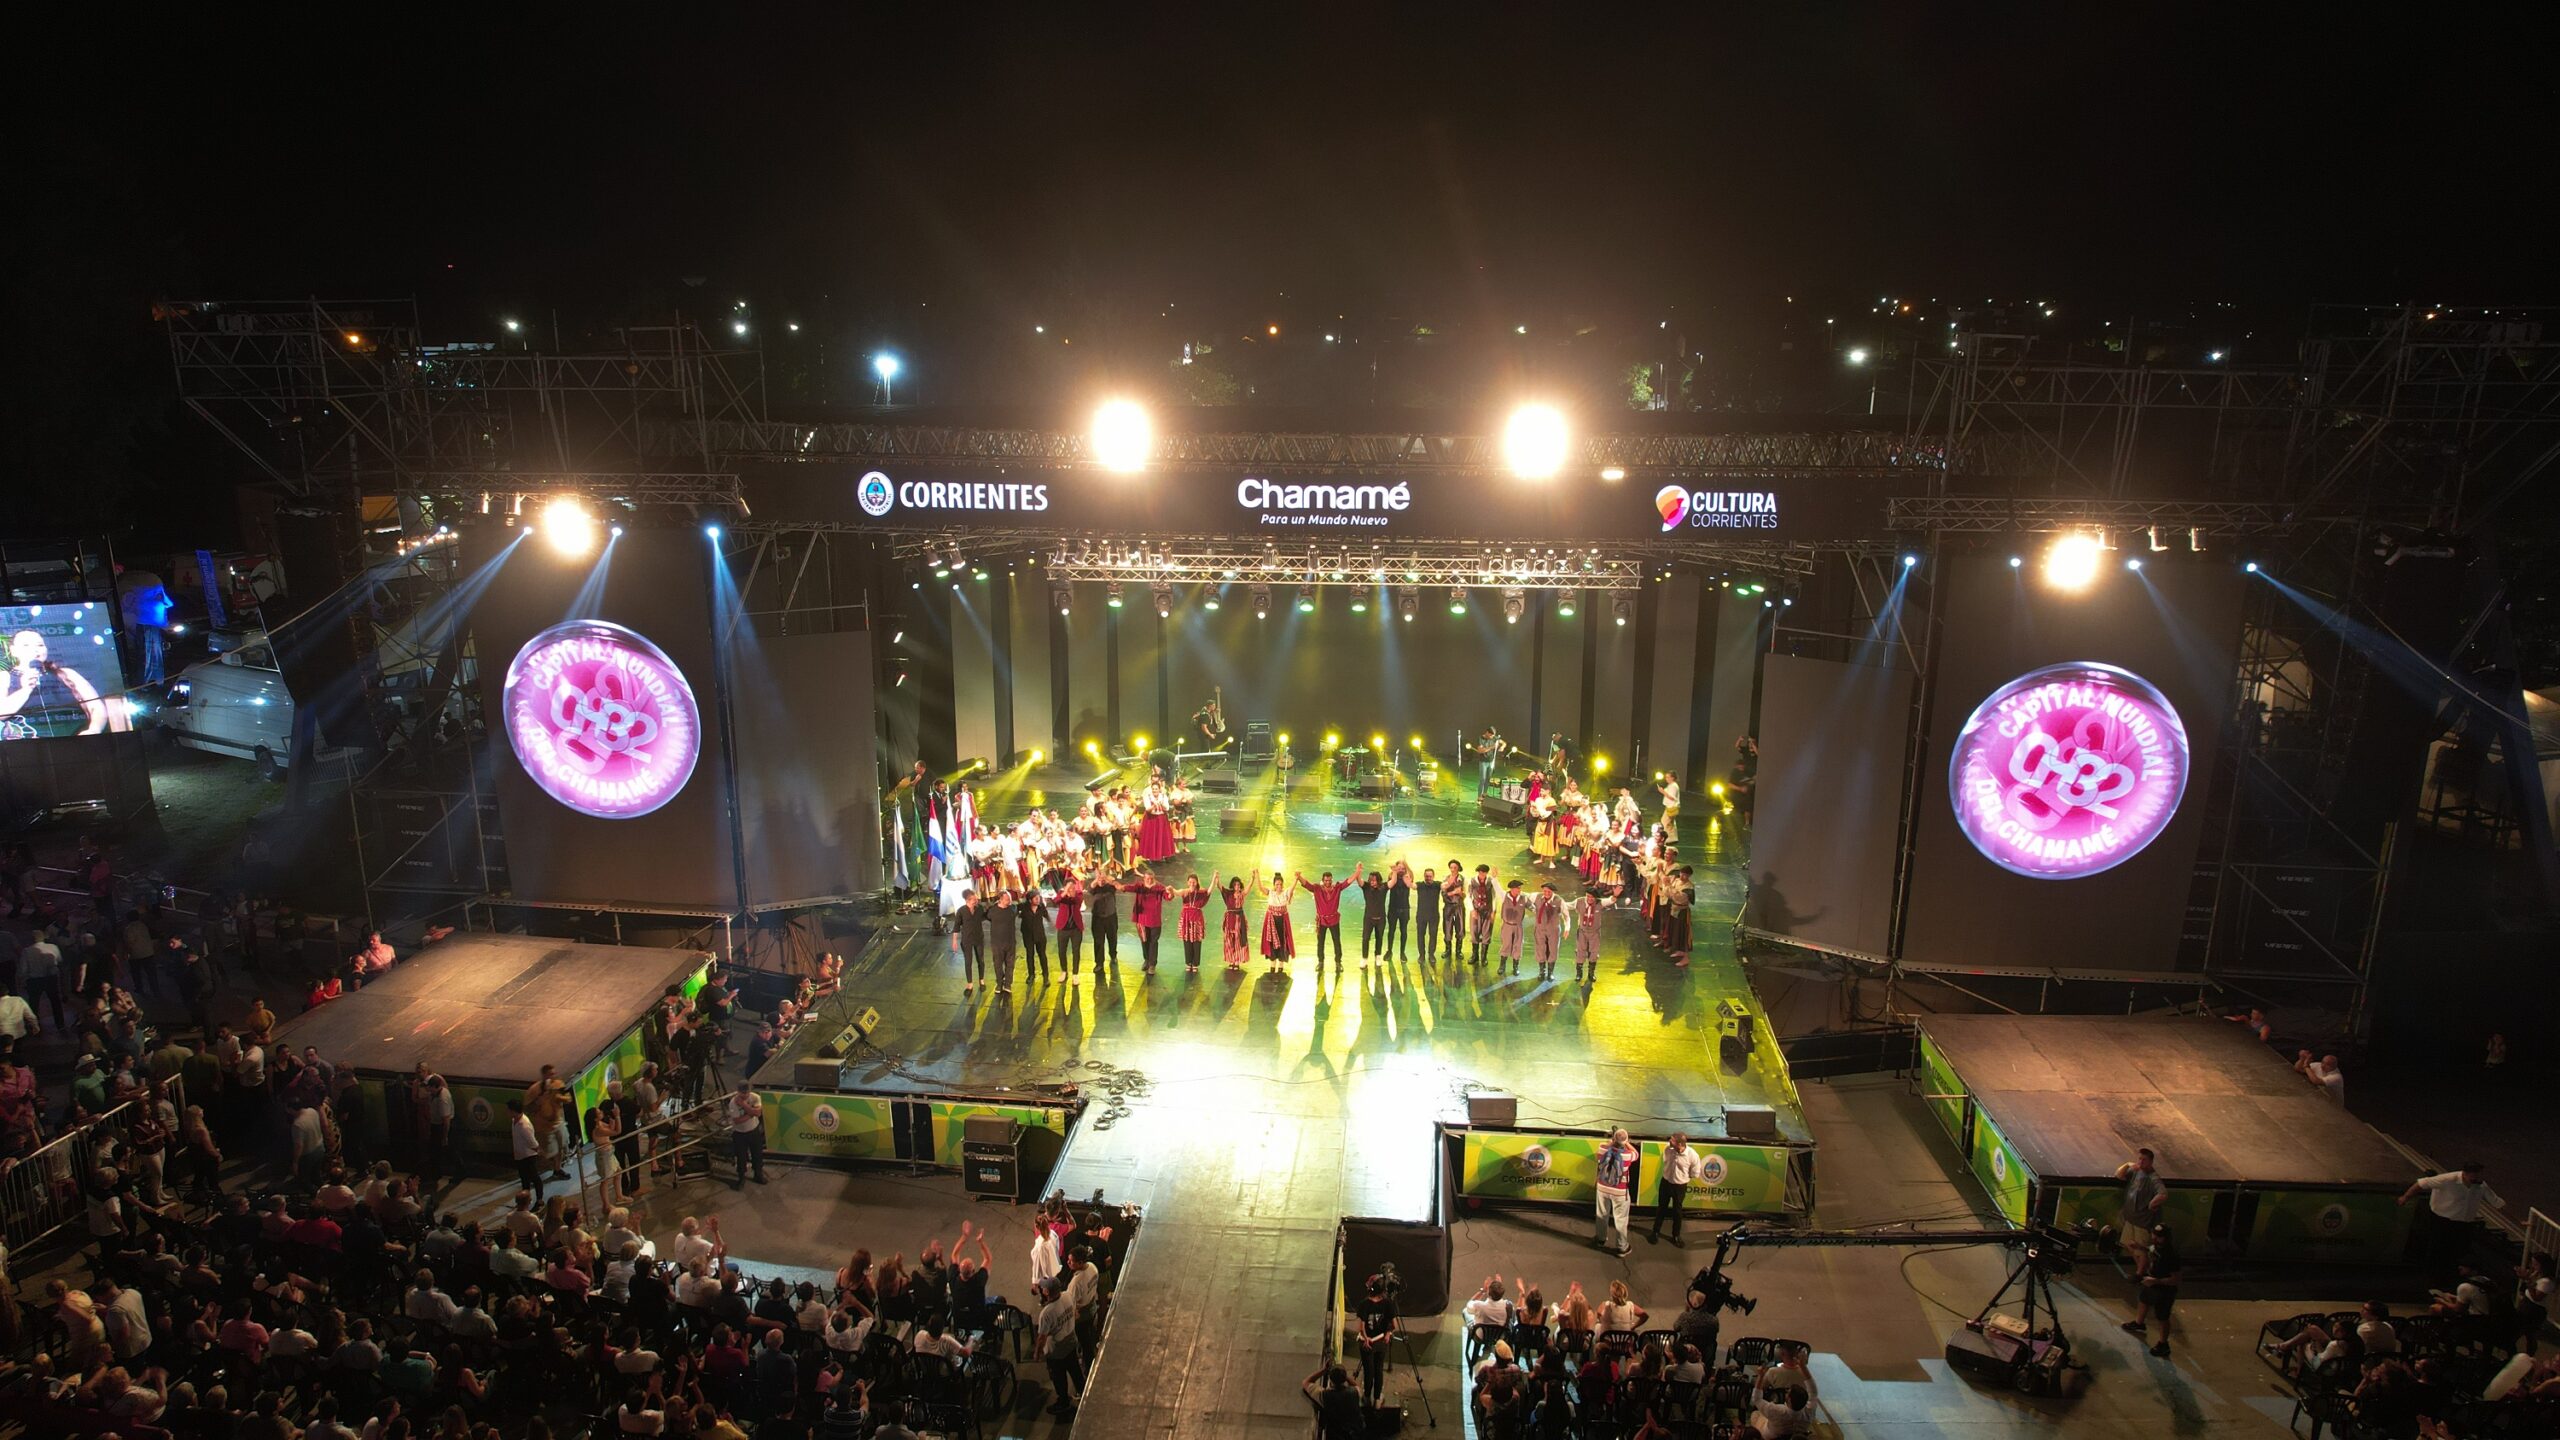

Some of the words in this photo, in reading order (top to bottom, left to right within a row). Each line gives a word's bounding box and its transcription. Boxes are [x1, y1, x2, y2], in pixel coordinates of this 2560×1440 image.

[900, 482, 1048, 511] CORRIENTES
[1238, 479, 1410, 510] Chamamé
[1692, 492, 1776, 513] CULTURA
[1260, 514, 1288, 525] Para
[1291, 515, 1306, 525] un
[1308, 514, 1348, 525] Mundo
[1350, 515, 1388, 526] Nuevo
[1691, 513, 1778, 528] CORRIENTES
[2101, 692, 2165, 782] MUNDIAL
[1999, 822, 2120, 859] CHAMAMÉ
[1502, 1175, 1570, 1186] CORRIENTES
[1685, 1186, 1745, 1197] ORRIENTES
